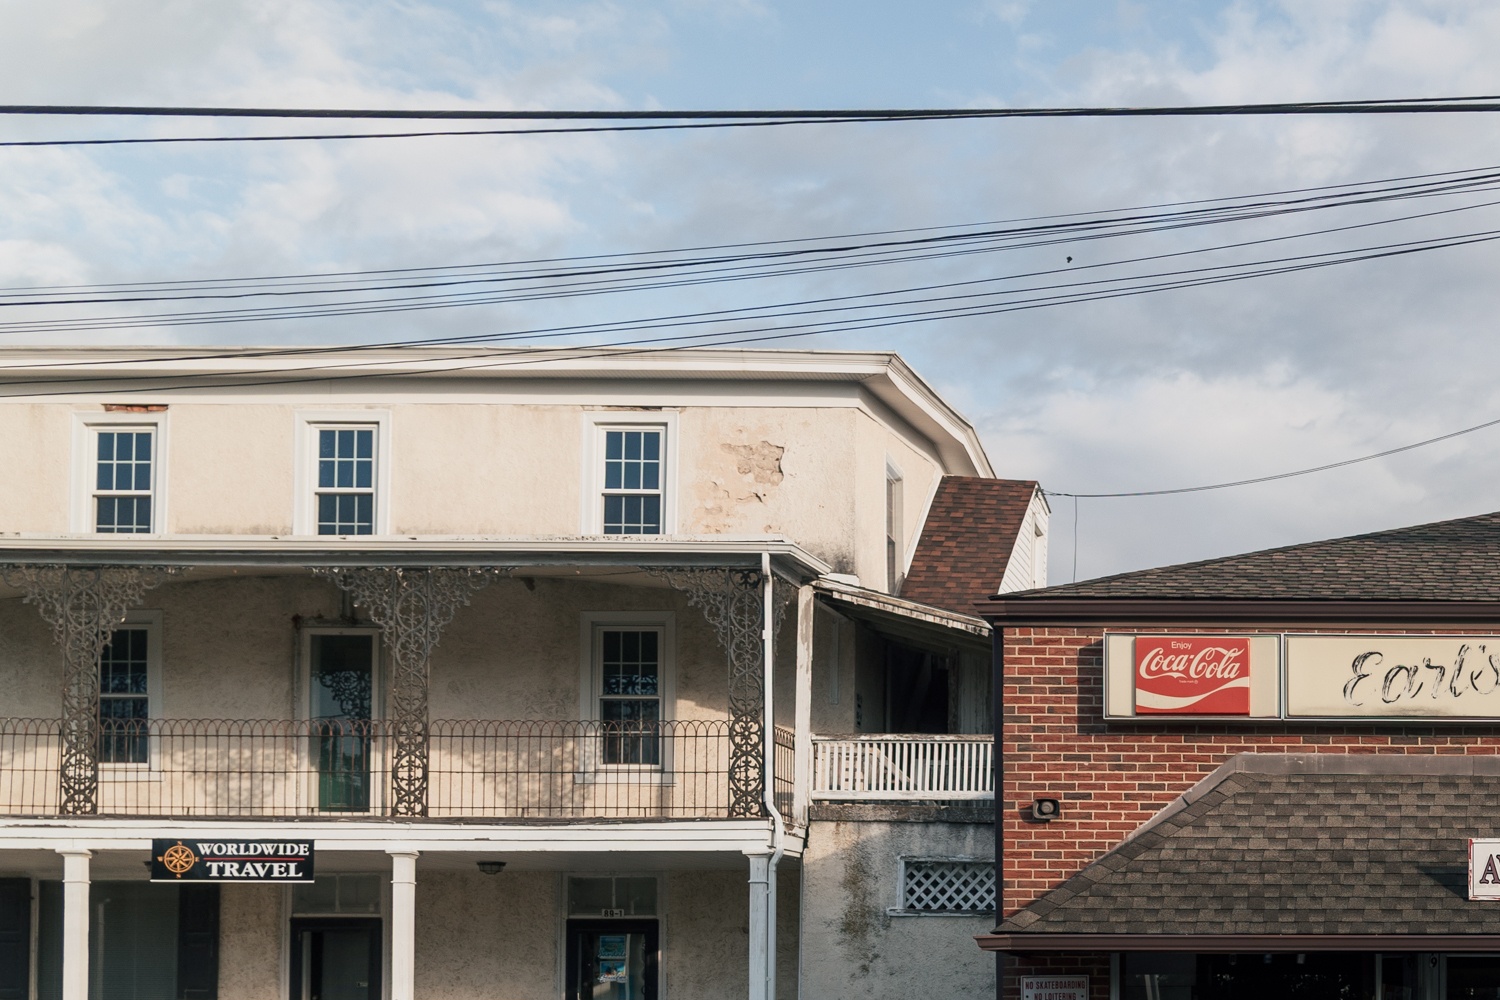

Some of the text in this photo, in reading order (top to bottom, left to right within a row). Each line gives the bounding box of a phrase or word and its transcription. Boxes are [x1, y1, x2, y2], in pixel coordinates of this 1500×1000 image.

[1171, 641, 1192, 650] Enjoy
[1139, 647, 1245, 679] Coca-Cola
[196, 843, 310, 856] WORLDWIDE
[206, 861, 303, 877] TRAVEL
[604, 909, 622, 917] 89-1
[1025, 981, 1086, 989] NO SKATEBOARDING
[1034, 993, 1077, 1000] NO LOITERING
